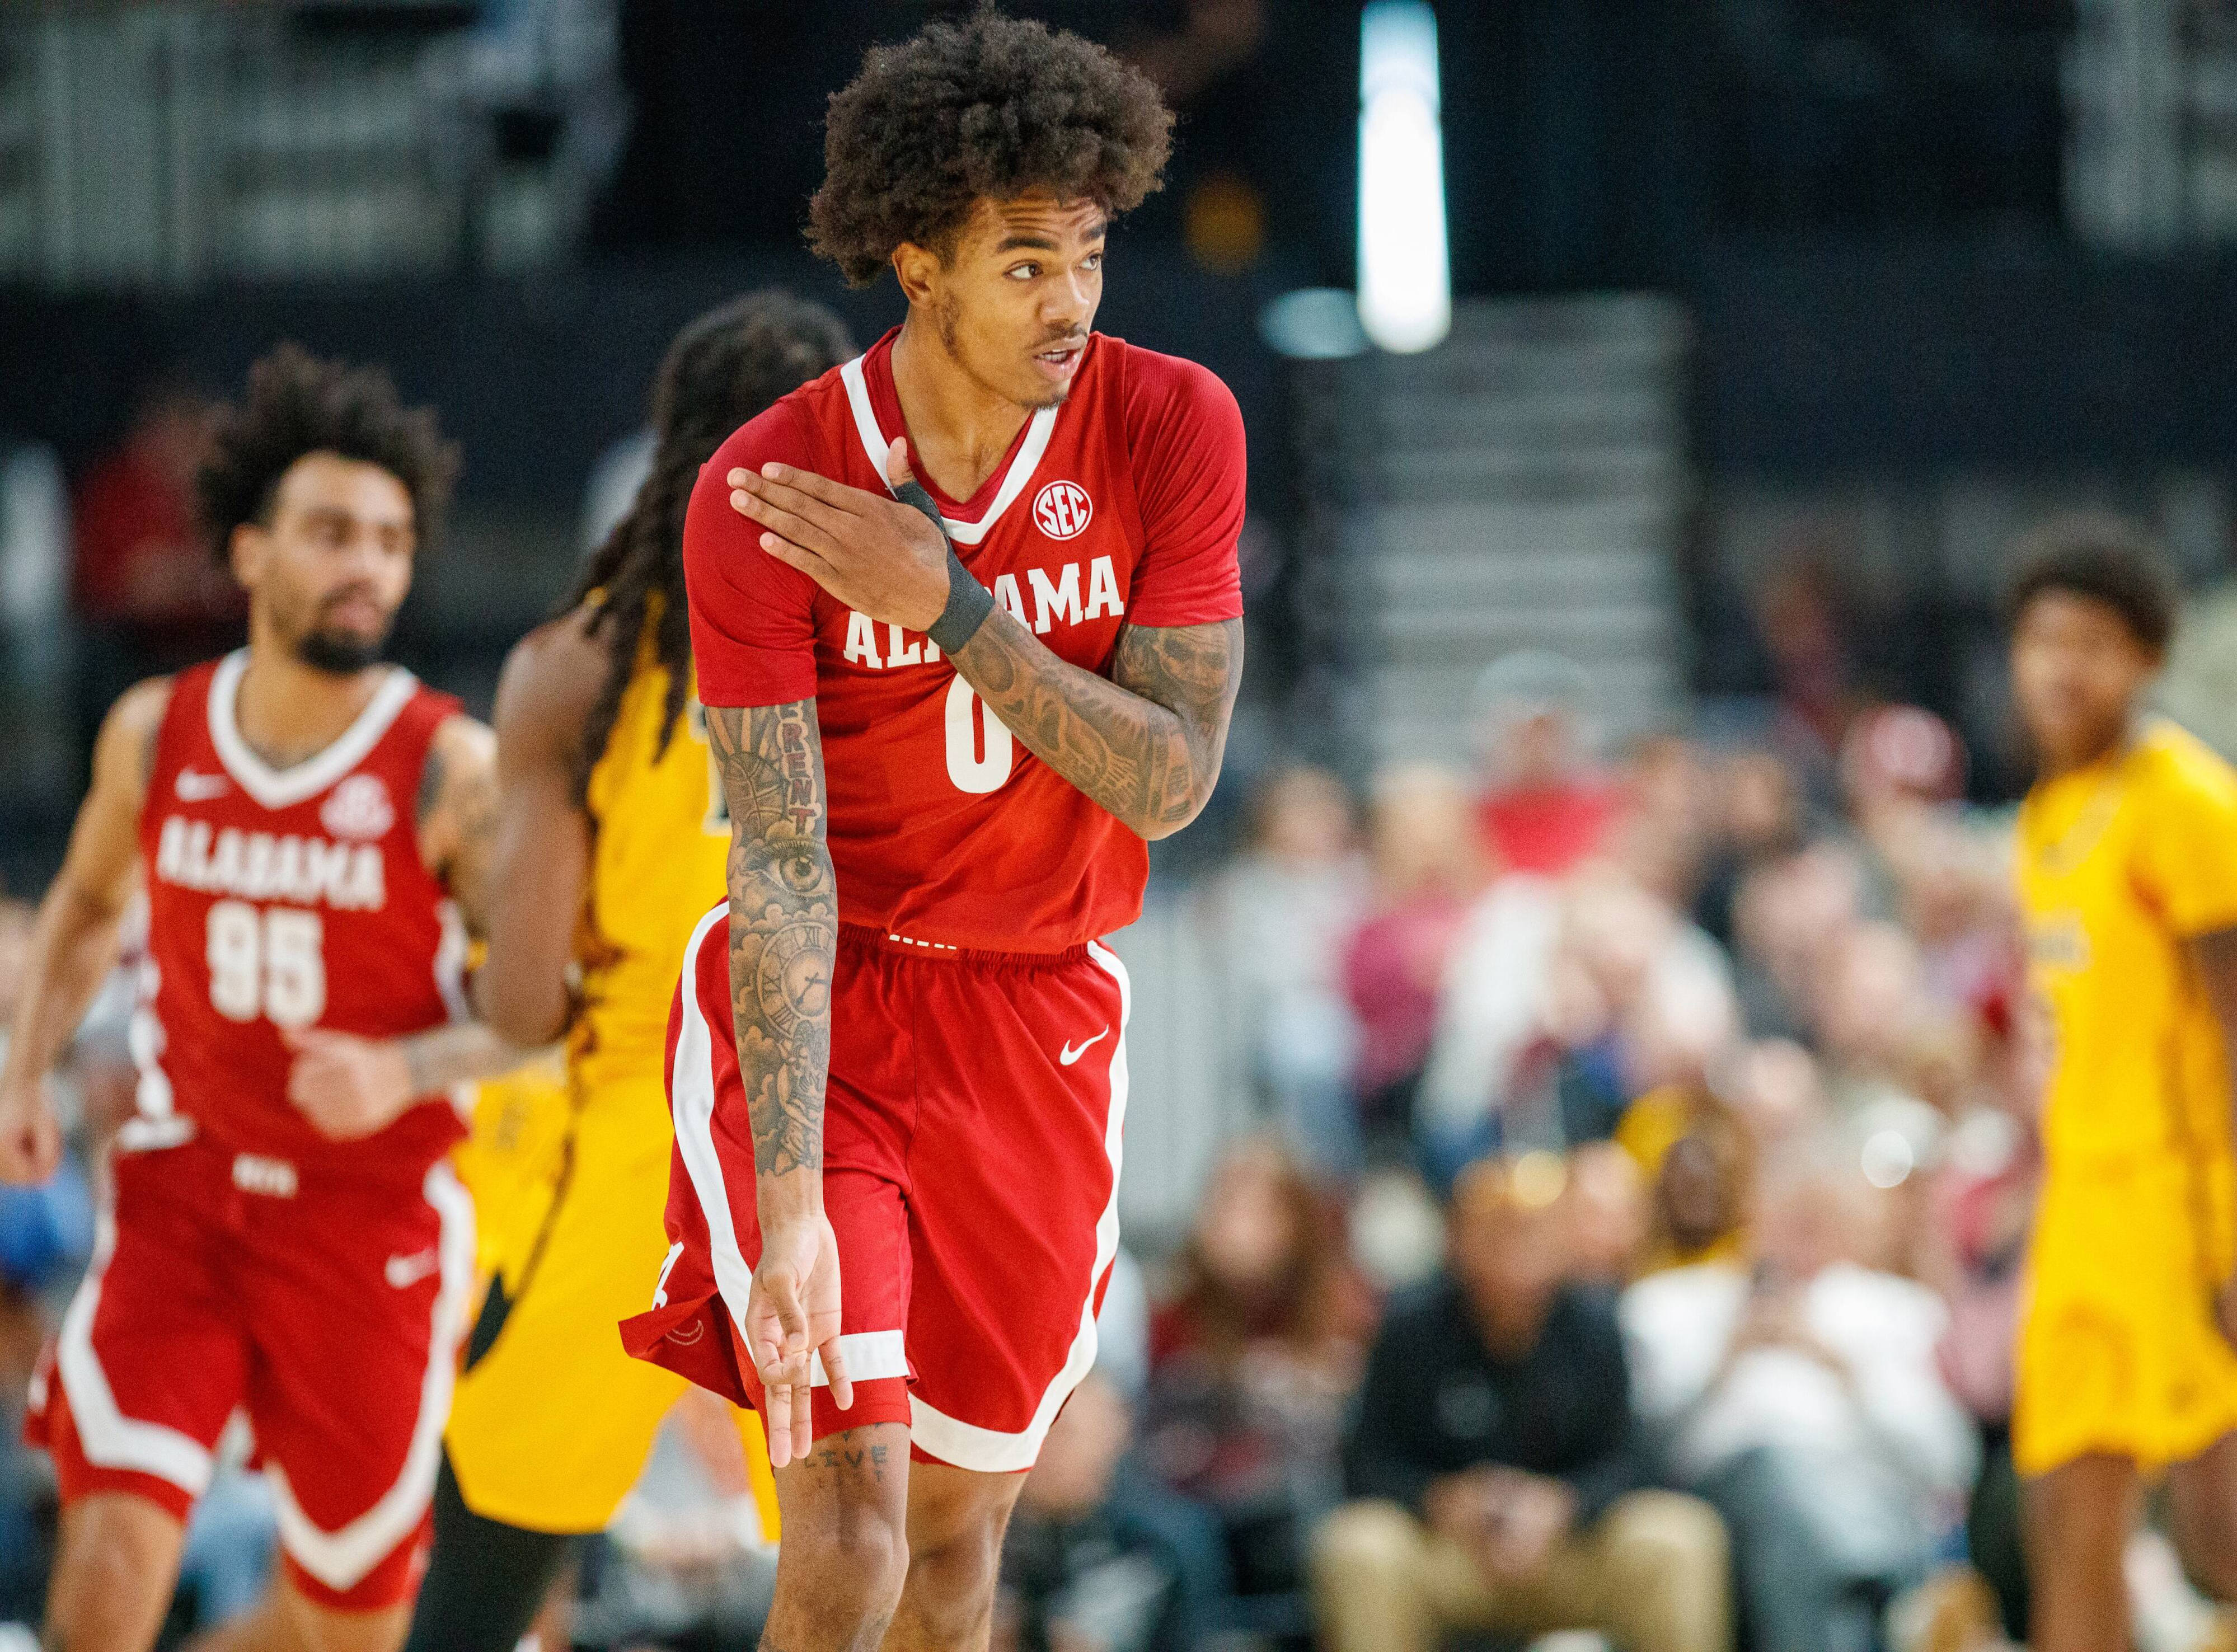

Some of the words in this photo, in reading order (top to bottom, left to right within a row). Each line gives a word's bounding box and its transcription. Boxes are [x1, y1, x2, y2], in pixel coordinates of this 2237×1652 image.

[1037, 485, 1088, 536] SEC
[843, 555, 1125, 669] ALAMA
[945, 671, 1012, 794] 0
[158, 816, 389, 911] ALABAMA
[207, 902, 326, 1029] 95
